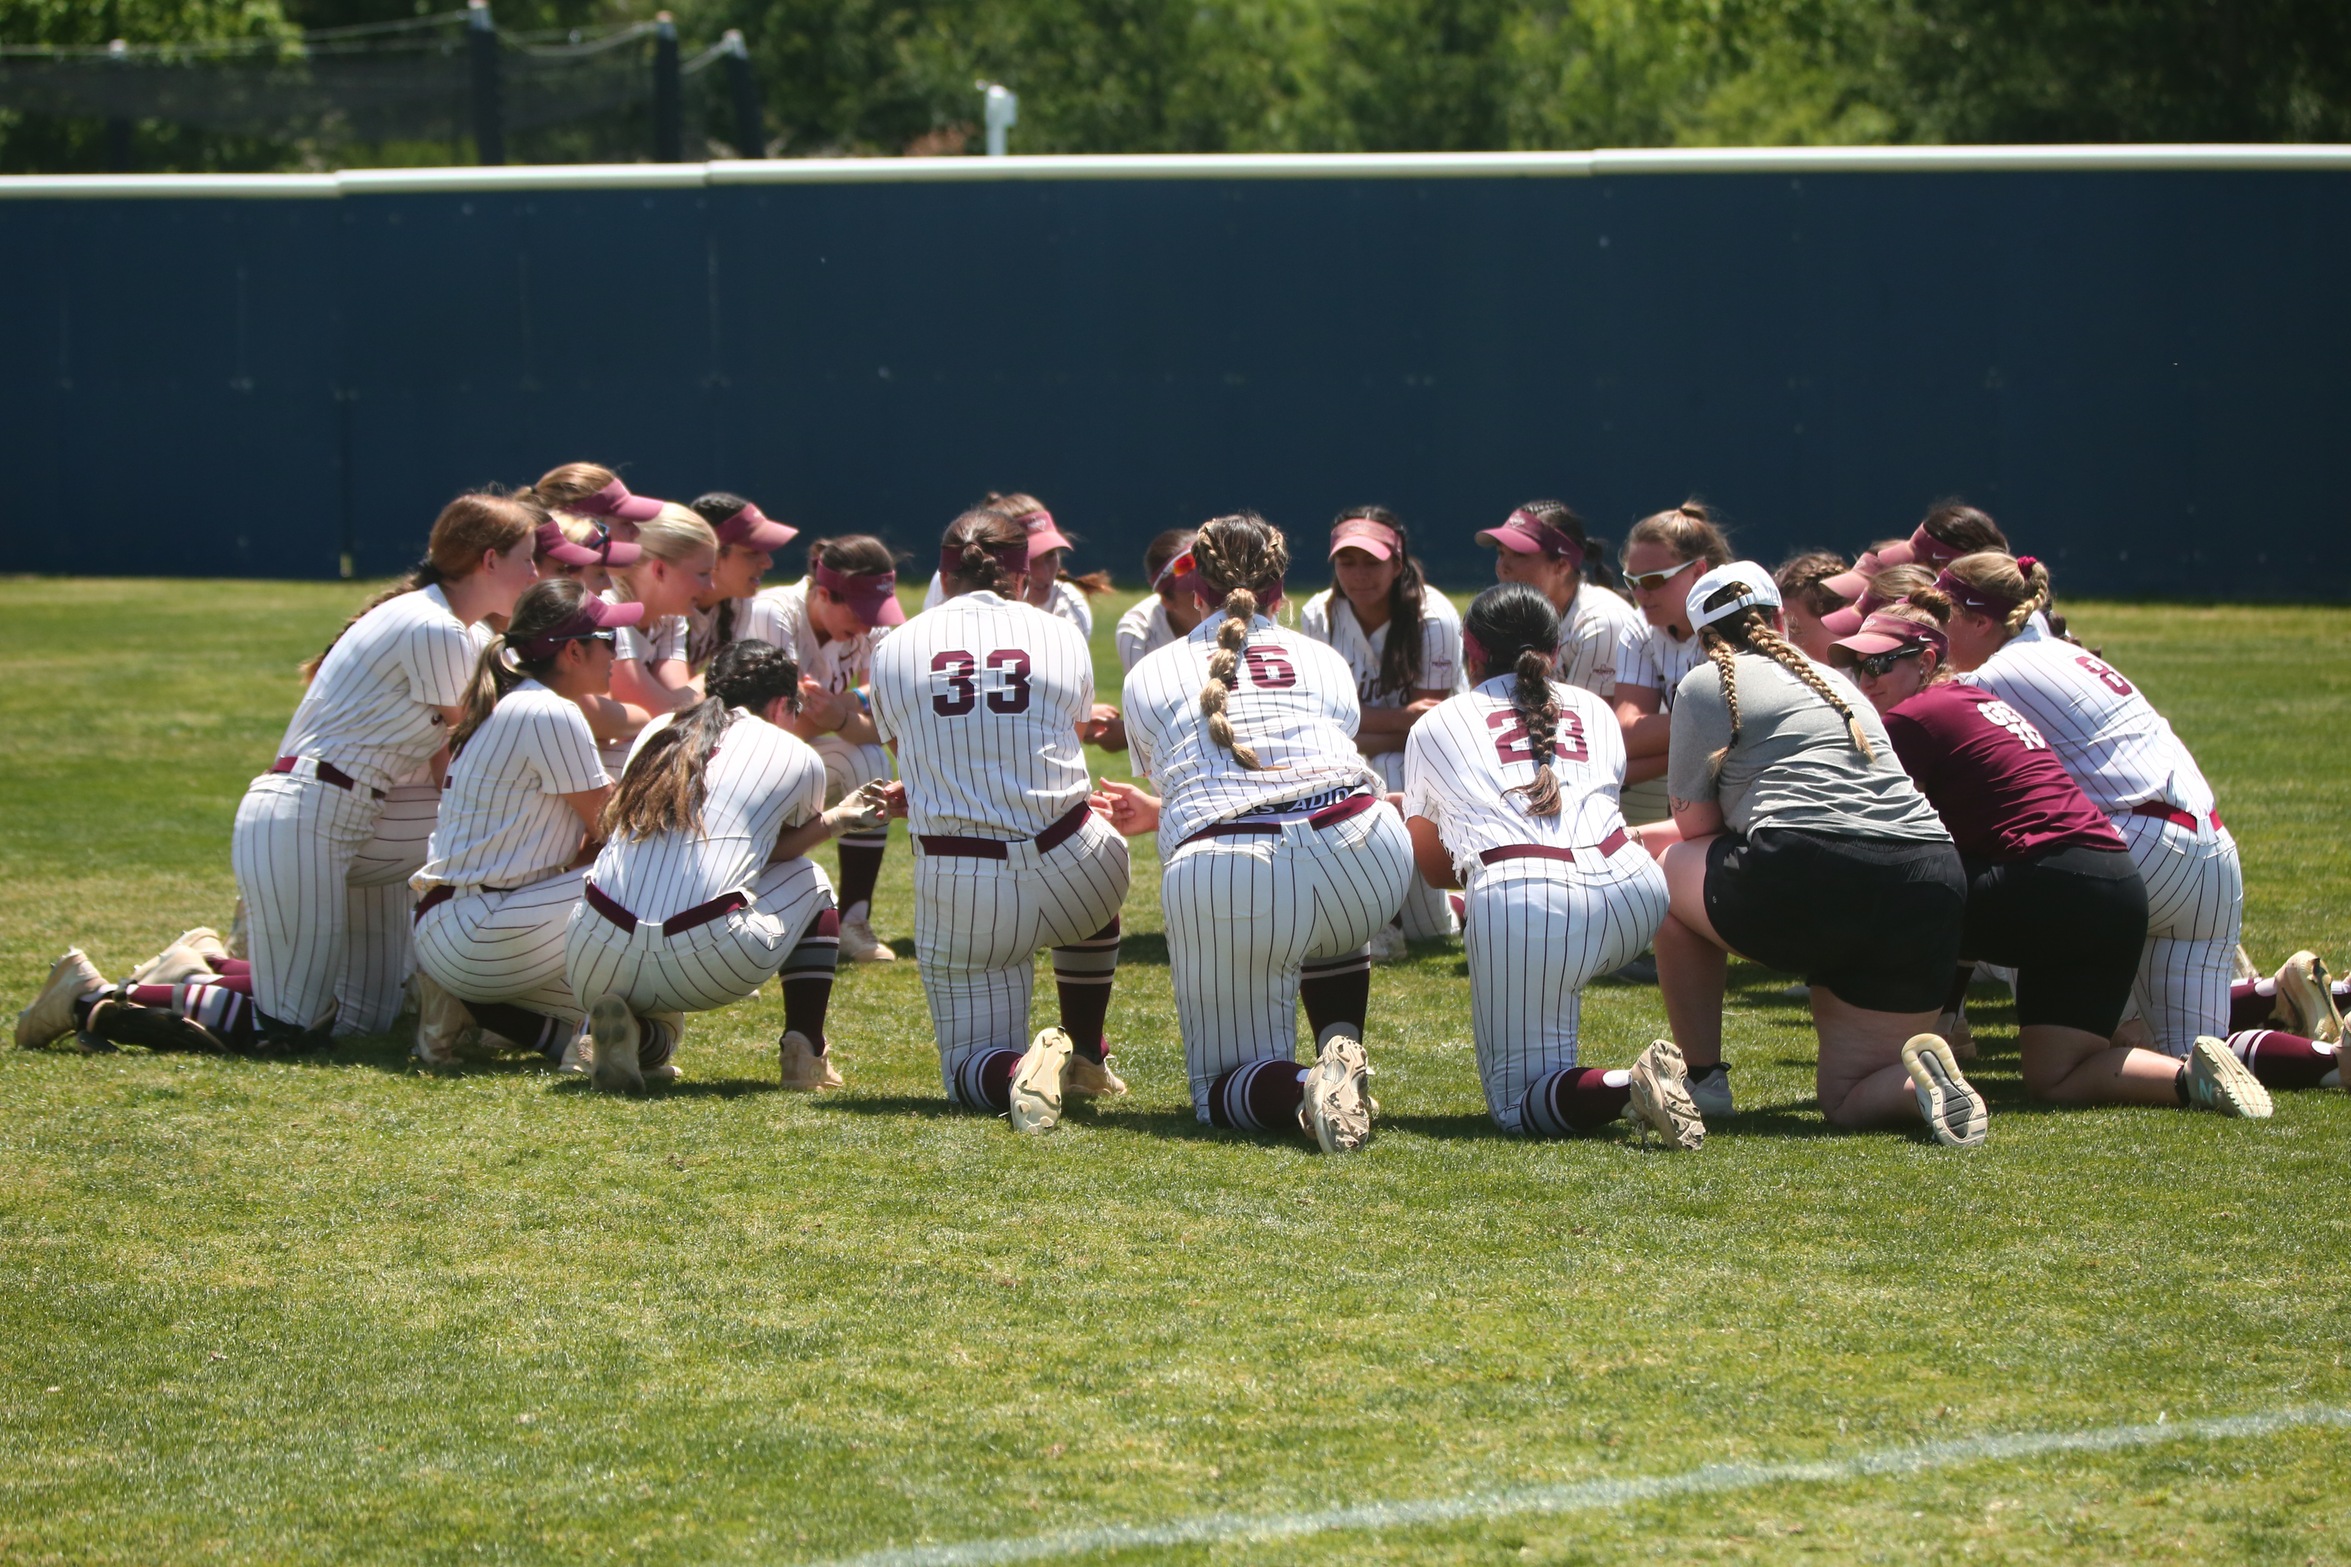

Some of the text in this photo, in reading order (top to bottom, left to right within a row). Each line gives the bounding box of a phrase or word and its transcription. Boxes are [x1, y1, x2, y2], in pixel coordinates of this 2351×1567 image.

[930, 649, 1031, 717] 33
[1206, 645, 1297, 690] 6
[2074, 655, 2133, 697] 8
[1485, 707, 1590, 765] 23
[1287, 786, 1357, 812] ADID
